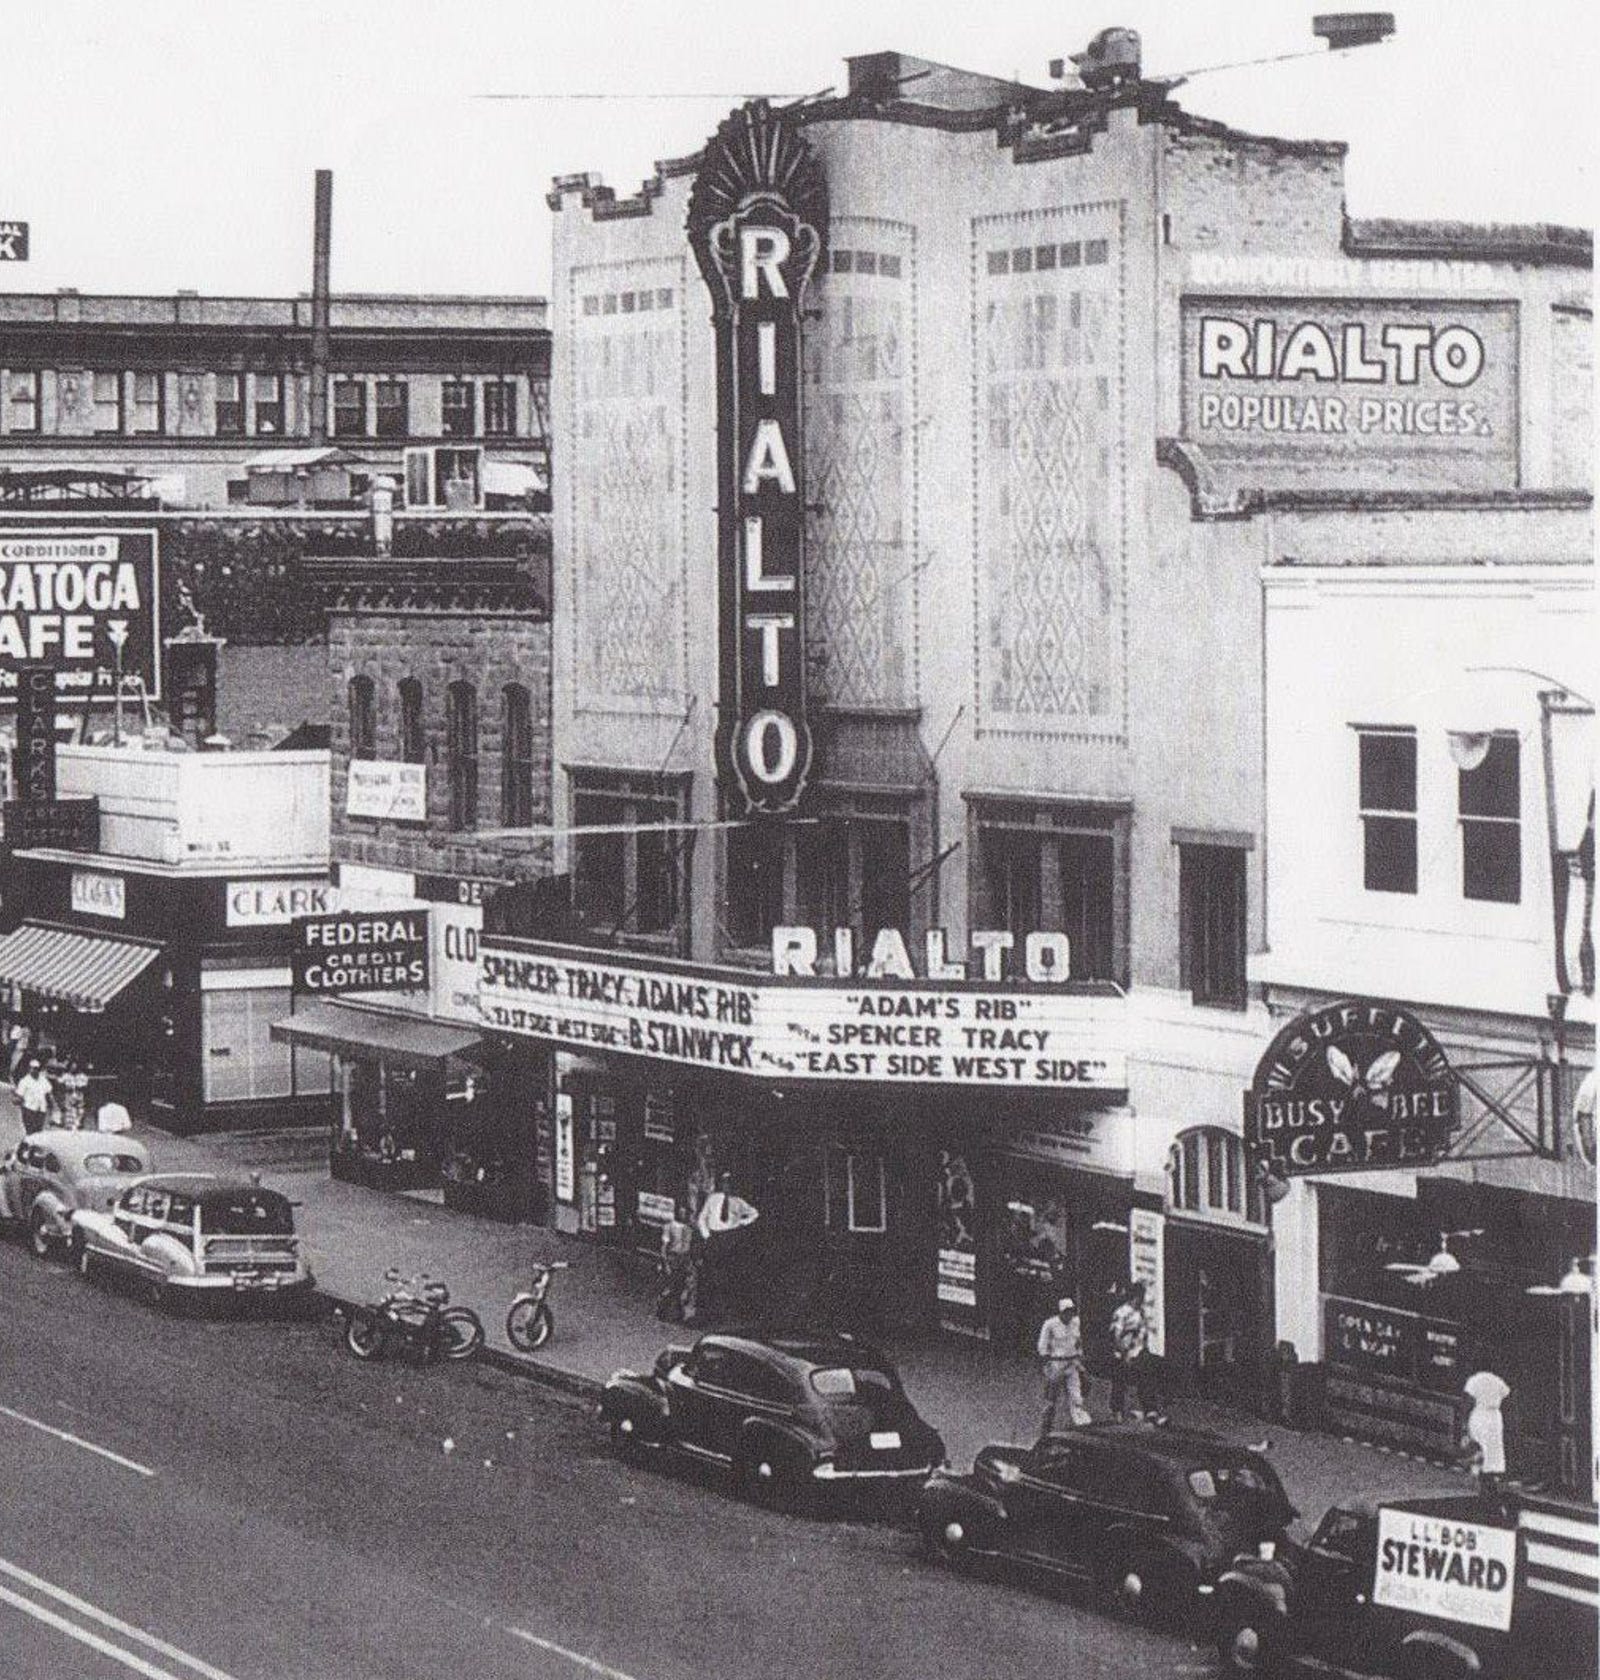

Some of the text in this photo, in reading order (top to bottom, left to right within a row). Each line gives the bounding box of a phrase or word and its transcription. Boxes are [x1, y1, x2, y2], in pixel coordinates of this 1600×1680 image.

[1199, 316, 1485, 388] RIALTO
[1200, 394, 1346, 432] POPULAR
[739, 226, 798, 785] RIALTO
[305, 919, 423, 947] FEDERAL
[325, 951, 405, 968] CREDIT
[771, 926, 1071, 982] RIALTO
[304, 962, 425, 989] CLOTHIERS
[482, 955, 560, 994] SPENCER
[565, 968, 627, 1004] TRACY
[975, 998, 1032, 1021] RIB"
[646, 1020, 755, 1068] STANWYCK
[827, 1023, 942, 1049] SPENCER
[961, 1026, 1051, 1052] TRACY
[795, 1051, 876, 1076] "EAST
[886, 1054, 942, 1077] SIDE
[952, 1056, 1026, 1080] WEST
[1034, 1058, 1107, 1083] SIDE"
[1264, 1099, 1345, 1130] BUSY
[1290, 1127, 1428, 1166] CAFE
[1381, 1537, 1508, 1593] STEWARD
